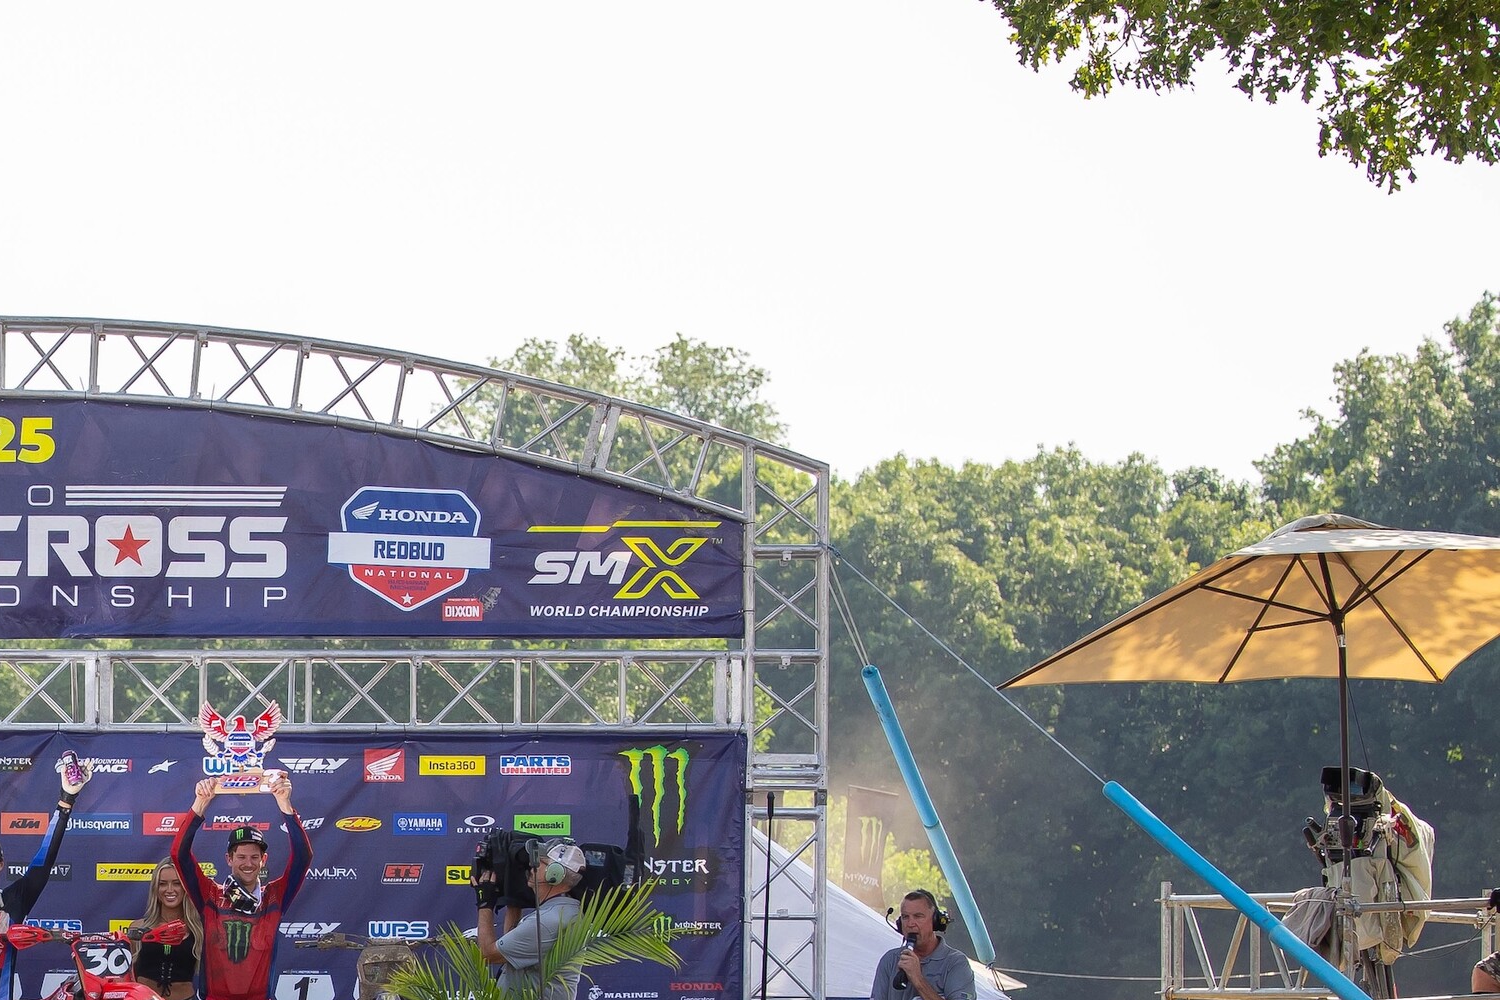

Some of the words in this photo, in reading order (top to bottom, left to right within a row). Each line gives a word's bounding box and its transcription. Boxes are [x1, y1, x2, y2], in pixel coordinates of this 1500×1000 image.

[378, 509, 470, 524] HONDA
[373, 540, 446, 561] REDBUD
[364, 568, 454, 580] NATIONAL
[527, 537, 709, 600] SMX
[444, 605, 481, 618] DIXXON
[529, 605, 585, 618] WORLD
[588, 605, 709, 618] CHAMPIONSHIP
[278, 758, 350, 770] FLY
[428, 760, 477, 771] Insta360
[500, 756, 570, 768] PARTS
[500, 766, 570, 775] UNLIMITED
[9, 818, 40, 829] KTM
[72, 817, 131, 832] Husqvarna
[213, 815, 254, 823] MX-ATV
[337, 817, 382, 831] FMF
[406, 818, 443, 828] YAMAHA
[520, 821, 565, 830] Kawasaki
[306, 865, 357, 877] AMURA
[386, 865, 422, 878] ETS
[643, 856, 710, 876] NSTER
[369, 921, 428, 940] WPS
[674, 920, 722, 931] MONSTER
[86, 948, 133, 976] 30
[669, 982, 724, 991] HONDA
